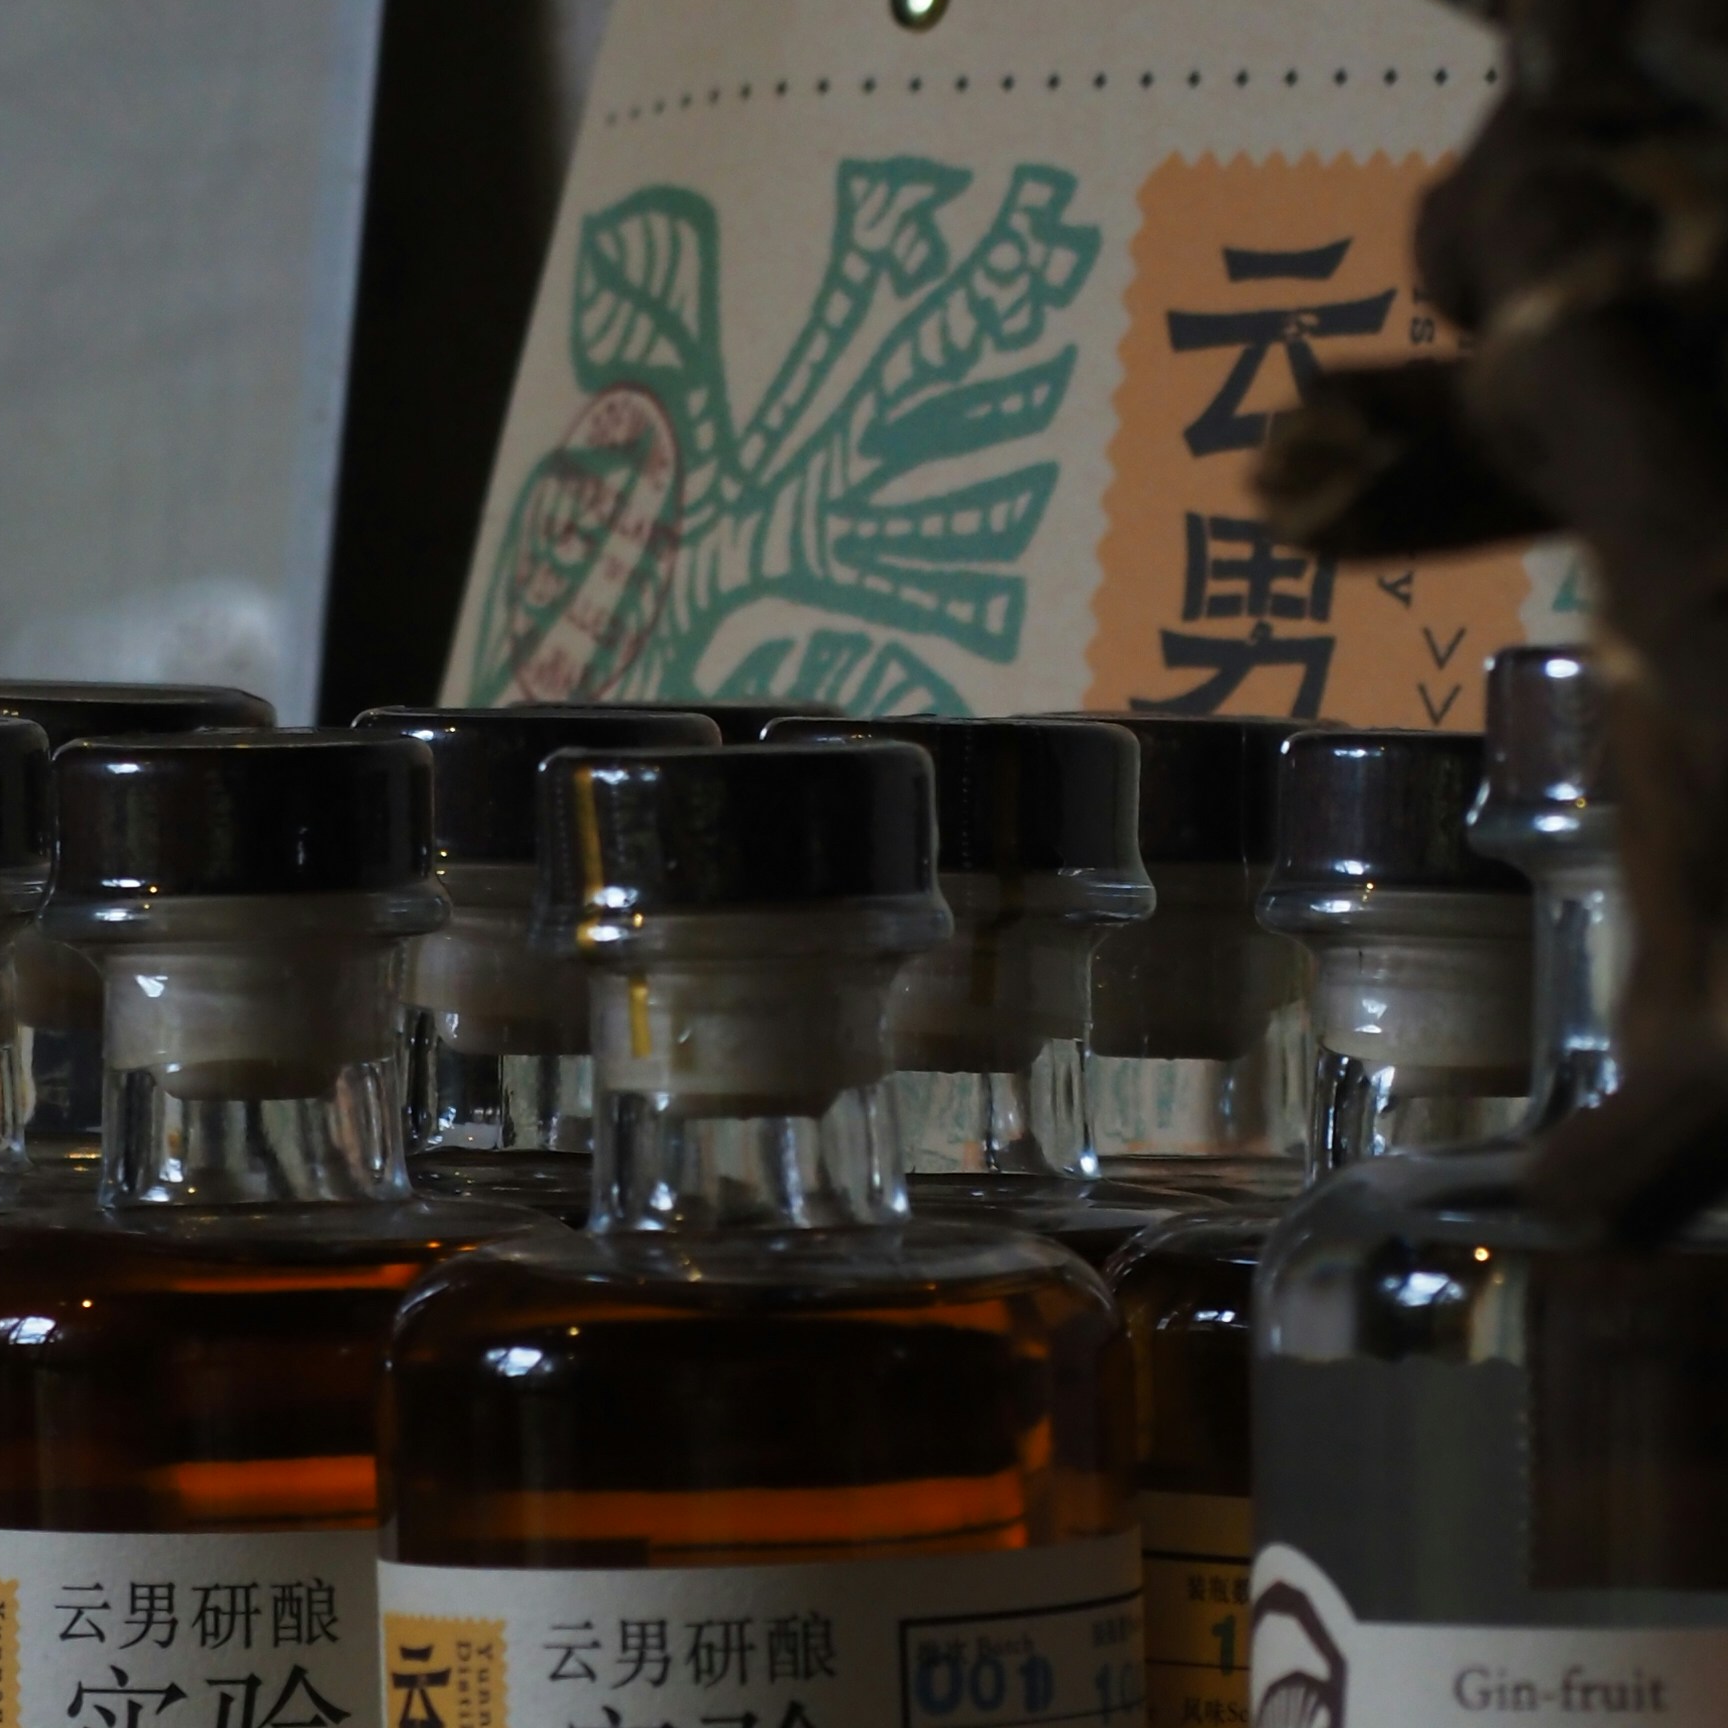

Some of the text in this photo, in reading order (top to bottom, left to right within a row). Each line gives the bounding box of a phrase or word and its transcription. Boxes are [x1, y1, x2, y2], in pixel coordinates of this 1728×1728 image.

[1130, 237, 1398, 720] 云男
[54, 1575, 339, 1650] 云男研酿
[540, 1614, 837, 1689] 云男研酿
[1452, 1666, 1668, 1713] Gin-fruit
